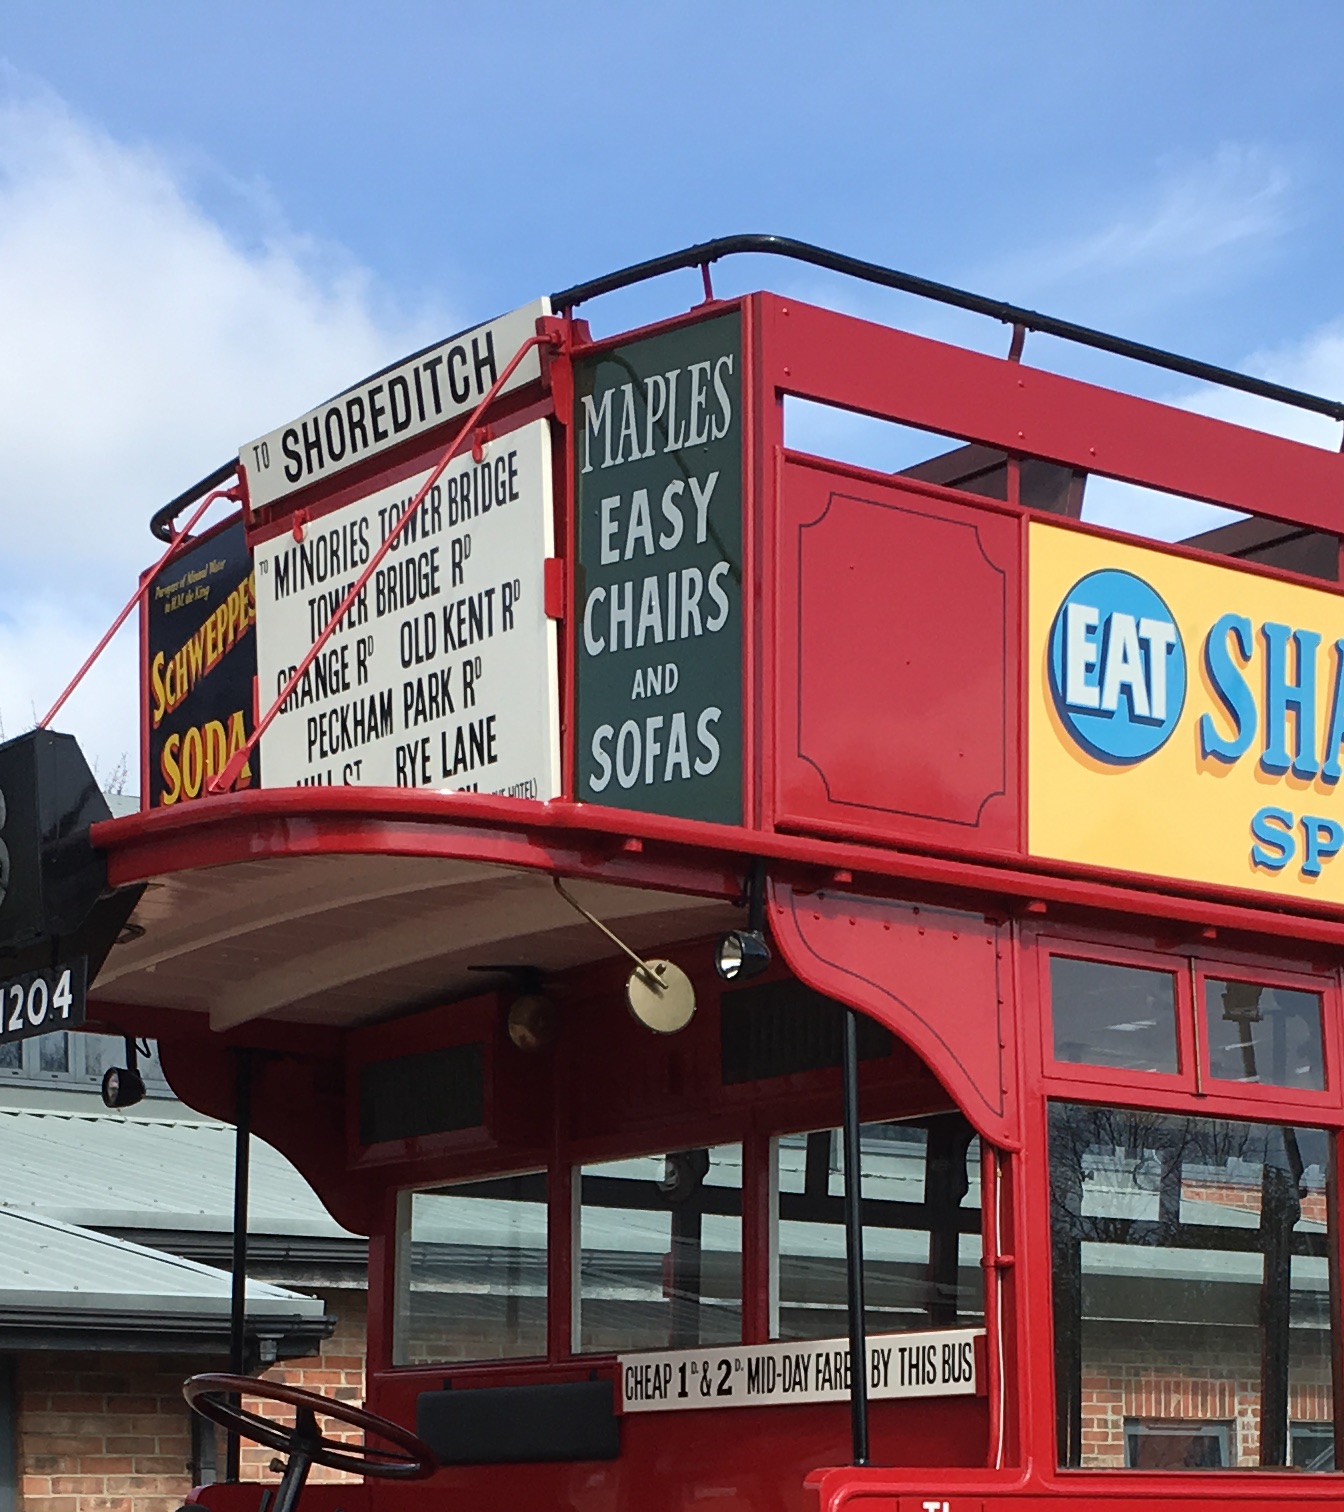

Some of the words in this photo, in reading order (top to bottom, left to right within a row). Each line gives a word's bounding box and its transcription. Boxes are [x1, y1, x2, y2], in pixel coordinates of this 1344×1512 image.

[253, 441, 271, 473] TO
[282, 331, 498, 483] SHOREDITCH
[581, 354, 735, 474] MAPLES
[258, 559, 269, 576] TO
[274, 516, 370, 601] MINORIES
[378, 485, 442, 551] TOWER
[448, 450, 520, 527] BRIDGE
[600, 471, 720, 565] EASY
[308, 582, 369, 644] TOWER
[375, 546, 441, 618] BRIDGE
[583, 562, 731, 657] CHAIRS
[277, 644, 351, 715] GRANGE
[400, 611, 438, 669] OLD
[443, 587, 496, 654] KENT
[631, 662, 680, 700] AND
[1063, 601, 1177, 722] EAT
[161, 709, 253, 806] SODA
[307, 687, 394, 764] PECKHAM
[403, 666, 455, 729] PARK
[396, 736, 433, 788] RYE
[442, 714, 499, 779] LANE
[589, 706, 722, 793] SOFAS
[624, 1361, 673, 1401] CHEAP
[700, 1360, 713, 1397] &
[746, 1352, 813, 1396] MID-DAY
[870, 1347, 894, 1389] BY
[898, 1343, 937, 1387] THIS
[941, 1341, 973, 1384] BUS
